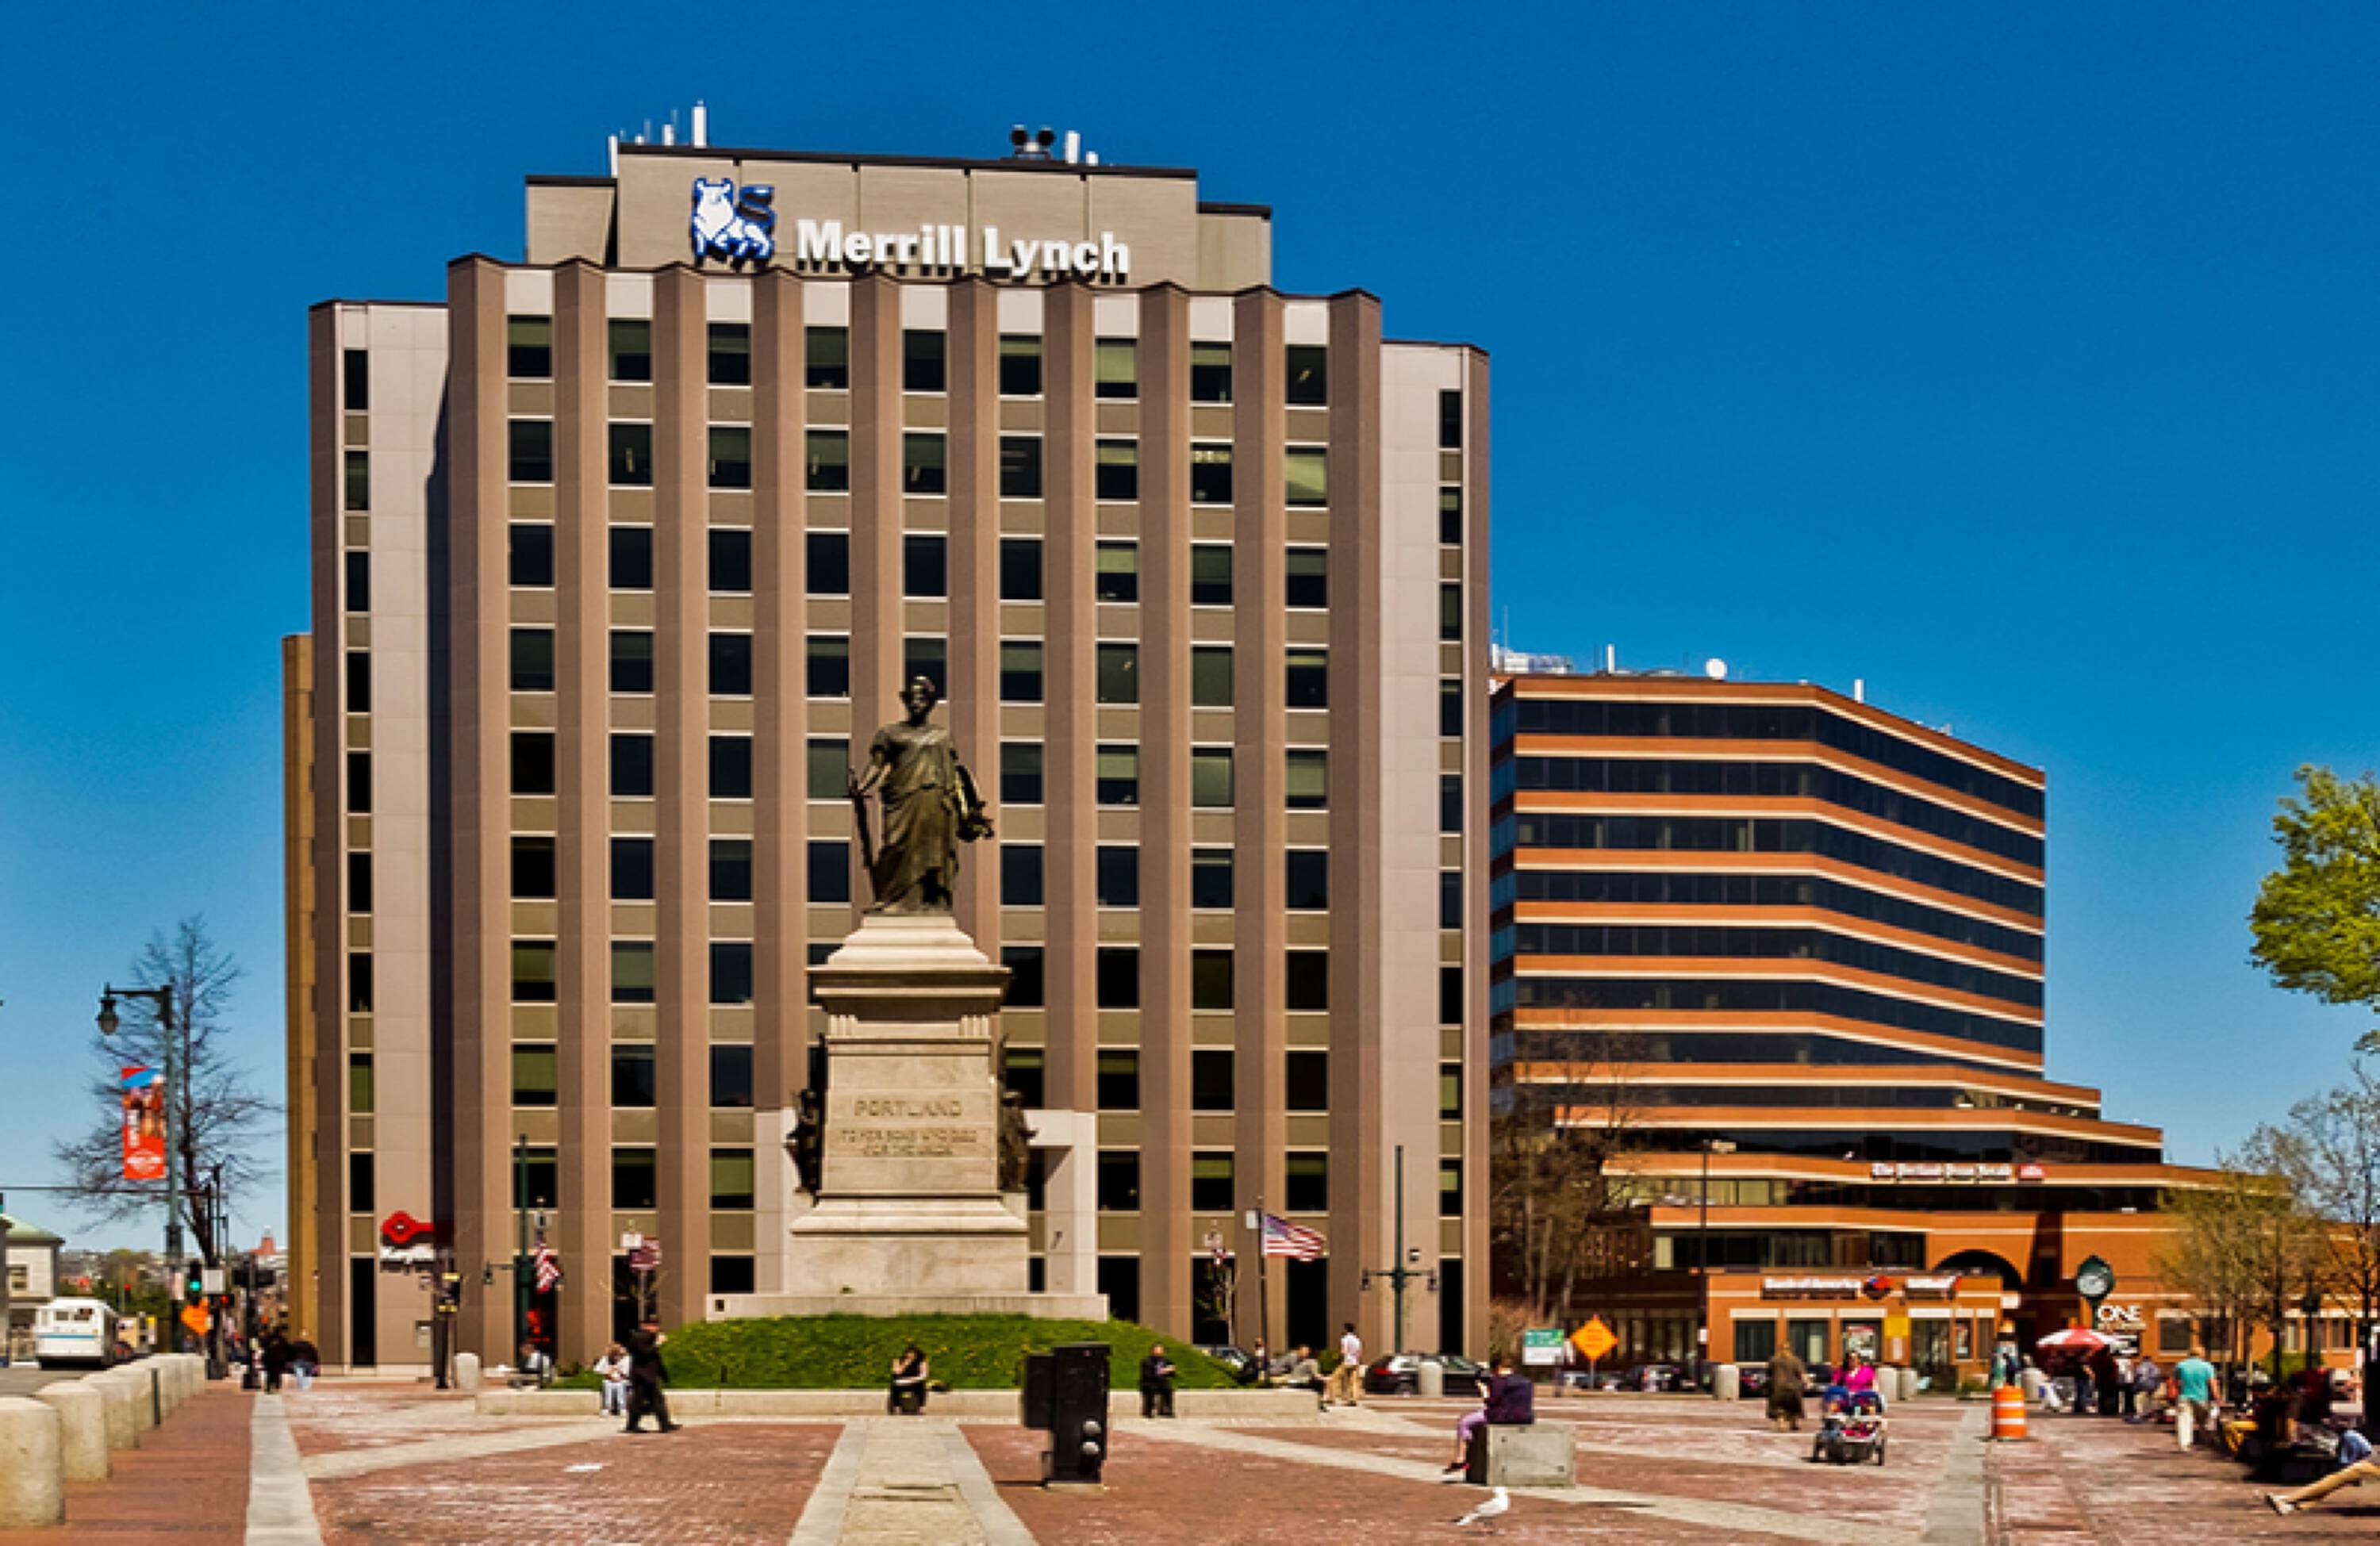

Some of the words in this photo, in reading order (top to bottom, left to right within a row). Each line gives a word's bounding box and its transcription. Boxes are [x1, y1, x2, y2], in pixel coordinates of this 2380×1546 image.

[796, 218, 965, 265] Merrill
[984, 225, 1130, 276] Lynch
[854, 1100, 962, 1117] PORTLAND
[2097, 1305, 2142, 1322] ONE
